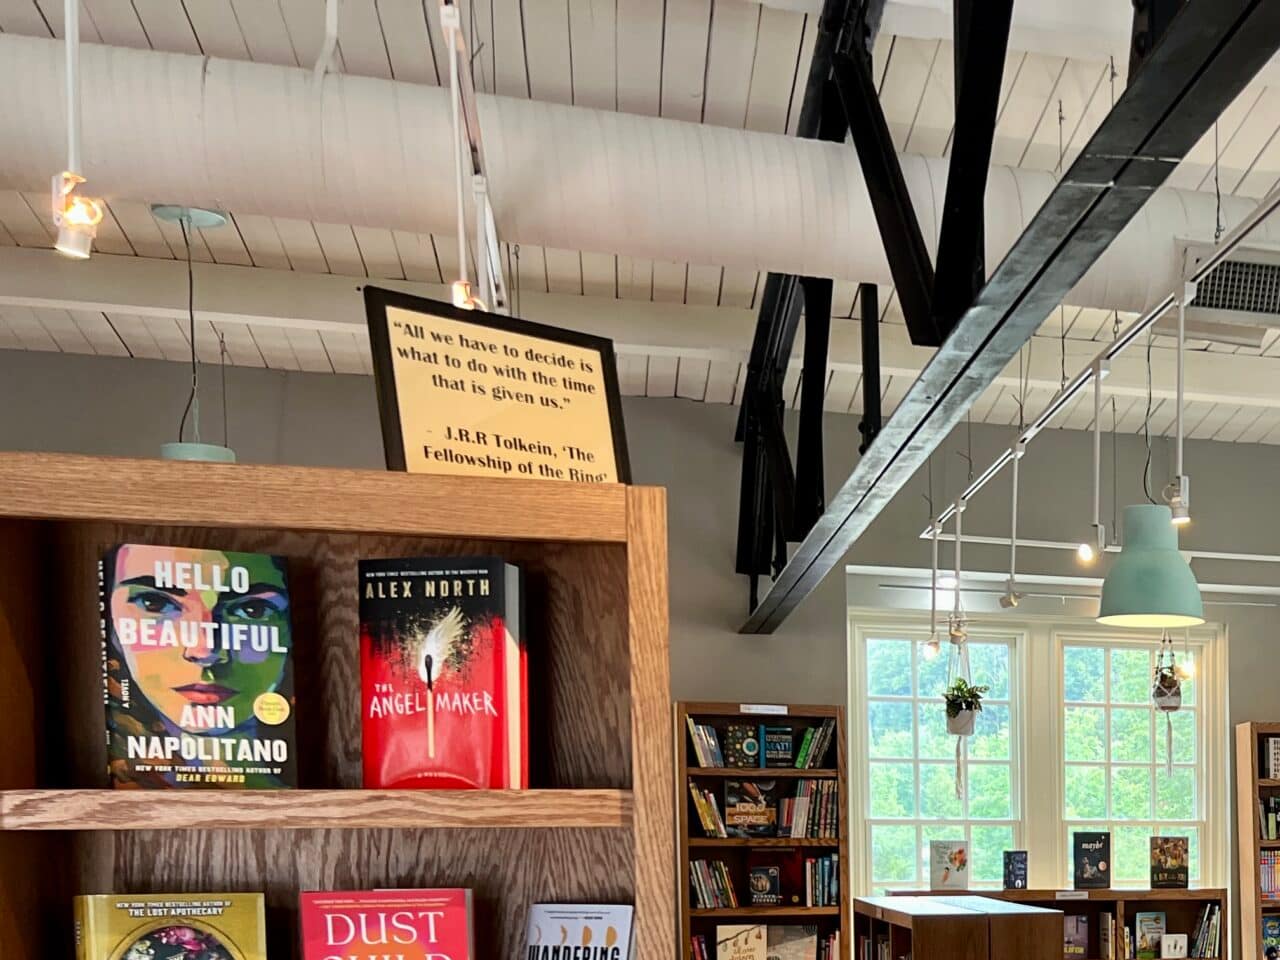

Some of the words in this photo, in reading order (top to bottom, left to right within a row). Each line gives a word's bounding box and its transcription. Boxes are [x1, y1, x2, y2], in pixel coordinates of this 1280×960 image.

[431, 330, 454, 345] we
[459, 334, 498, 354] have
[503, 344, 519, 358] to
[525, 348, 575, 369] decide
[580, 358, 594, 373] is
[397, 346, 438, 365] what
[444, 355, 461, 369] to
[467, 358, 487, 374] do
[493, 364, 527, 382] with
[532, 371, 557, 387] the
[562, 378, 596, 395] time
[432, 374, 466, 392] that
[472, 380, 486, 395] is
[492, 386, 534, 404] given
[445, 426, 488, 446] J.R.R
[493, 434, 557, 459] Tolkein,
[423, 446, 512, 473] Fellowship
[519, 461, 534, 474] of
[539, 465, 563, 480] the
[154, 560, 250, 594] HELLO
[365, 581, 412, 599] ALEX
[425, 579, 490, 597] NORTH
[118, 617, 288, 653] BEAUTIFUL
[375, 683, 394, 692] THE
[180, 705, 235, 729] ANN
[370, 692, 426, 718] ANGEL
[436, 691, 498, 717] MAKER
[127, 736, 288, 762] NAPOLITANO
[176, 773, 201, 782] DEAR
[205, 774, 245, 783] EDWARD
[171, 907, 223, 916] APOTHECARY
[324, 911, 445, 946] DUST
